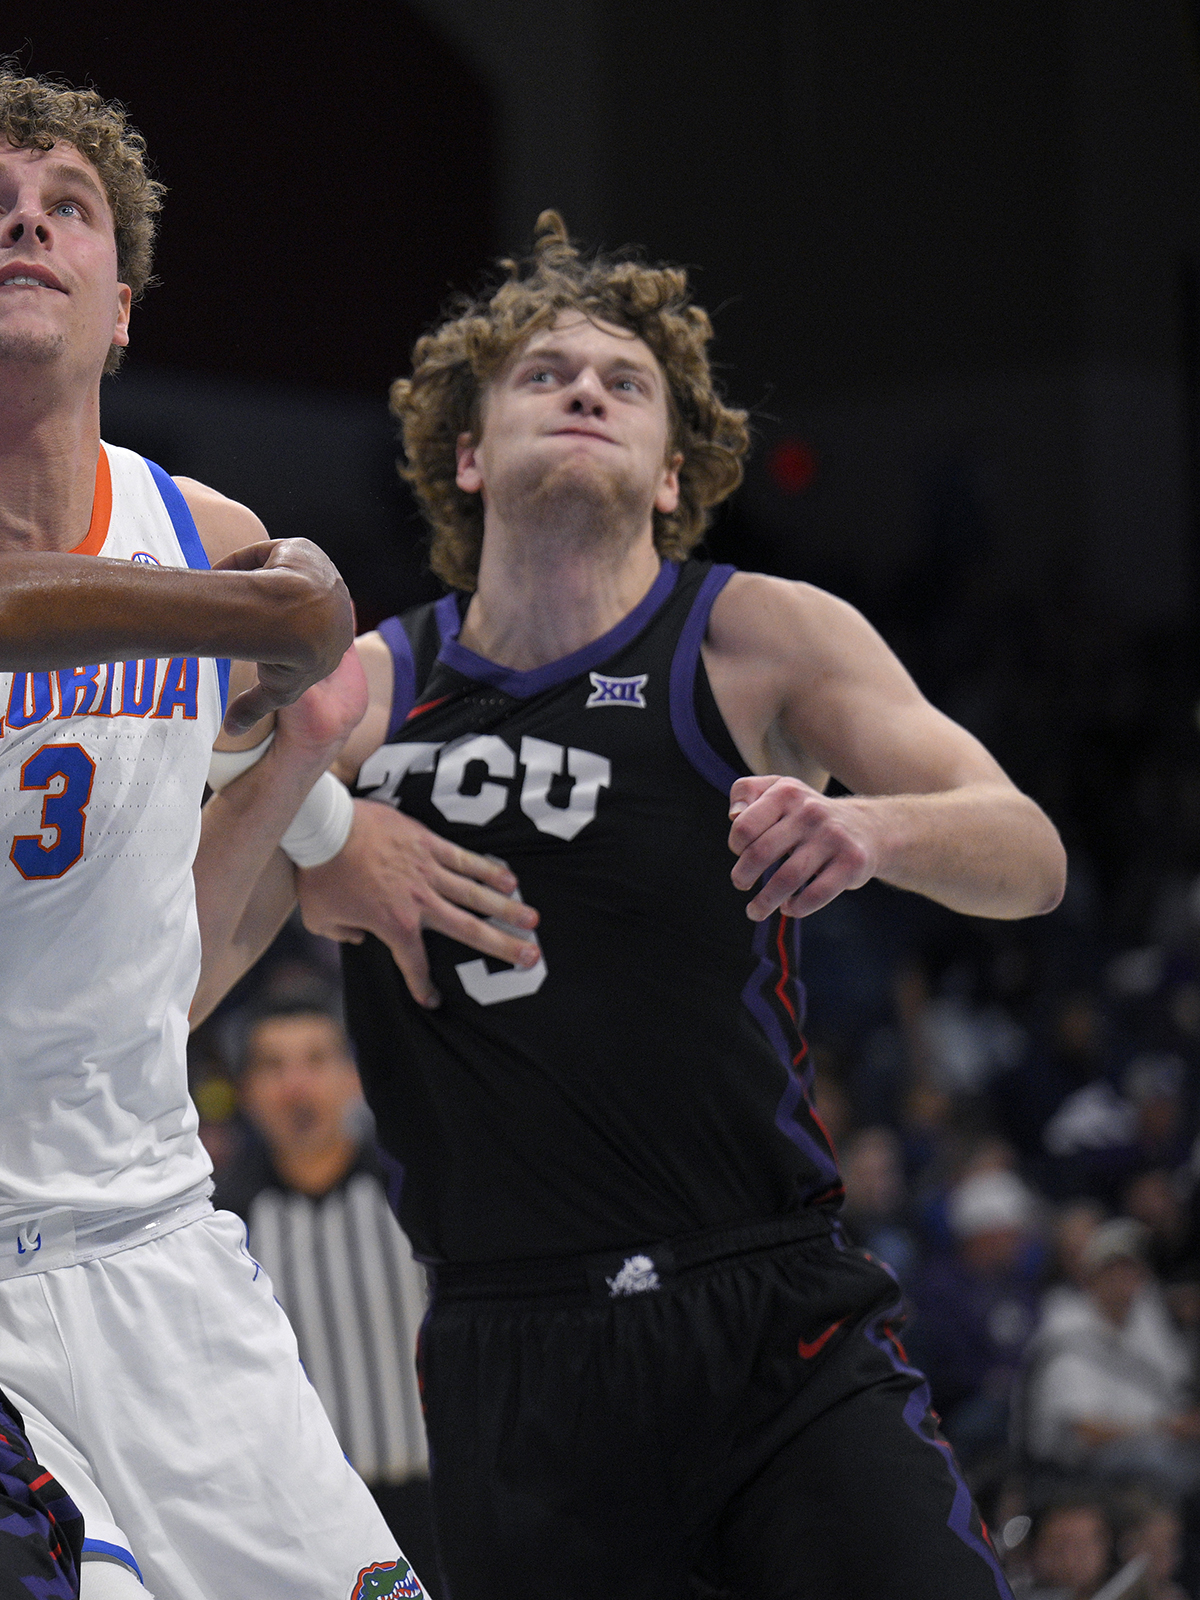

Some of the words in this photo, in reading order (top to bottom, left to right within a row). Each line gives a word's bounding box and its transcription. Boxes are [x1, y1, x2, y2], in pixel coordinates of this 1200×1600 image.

[589, 674, 646, 706] XII
[9, 742, 97, 880] 3
[356, 732, 612, 842] TCU
